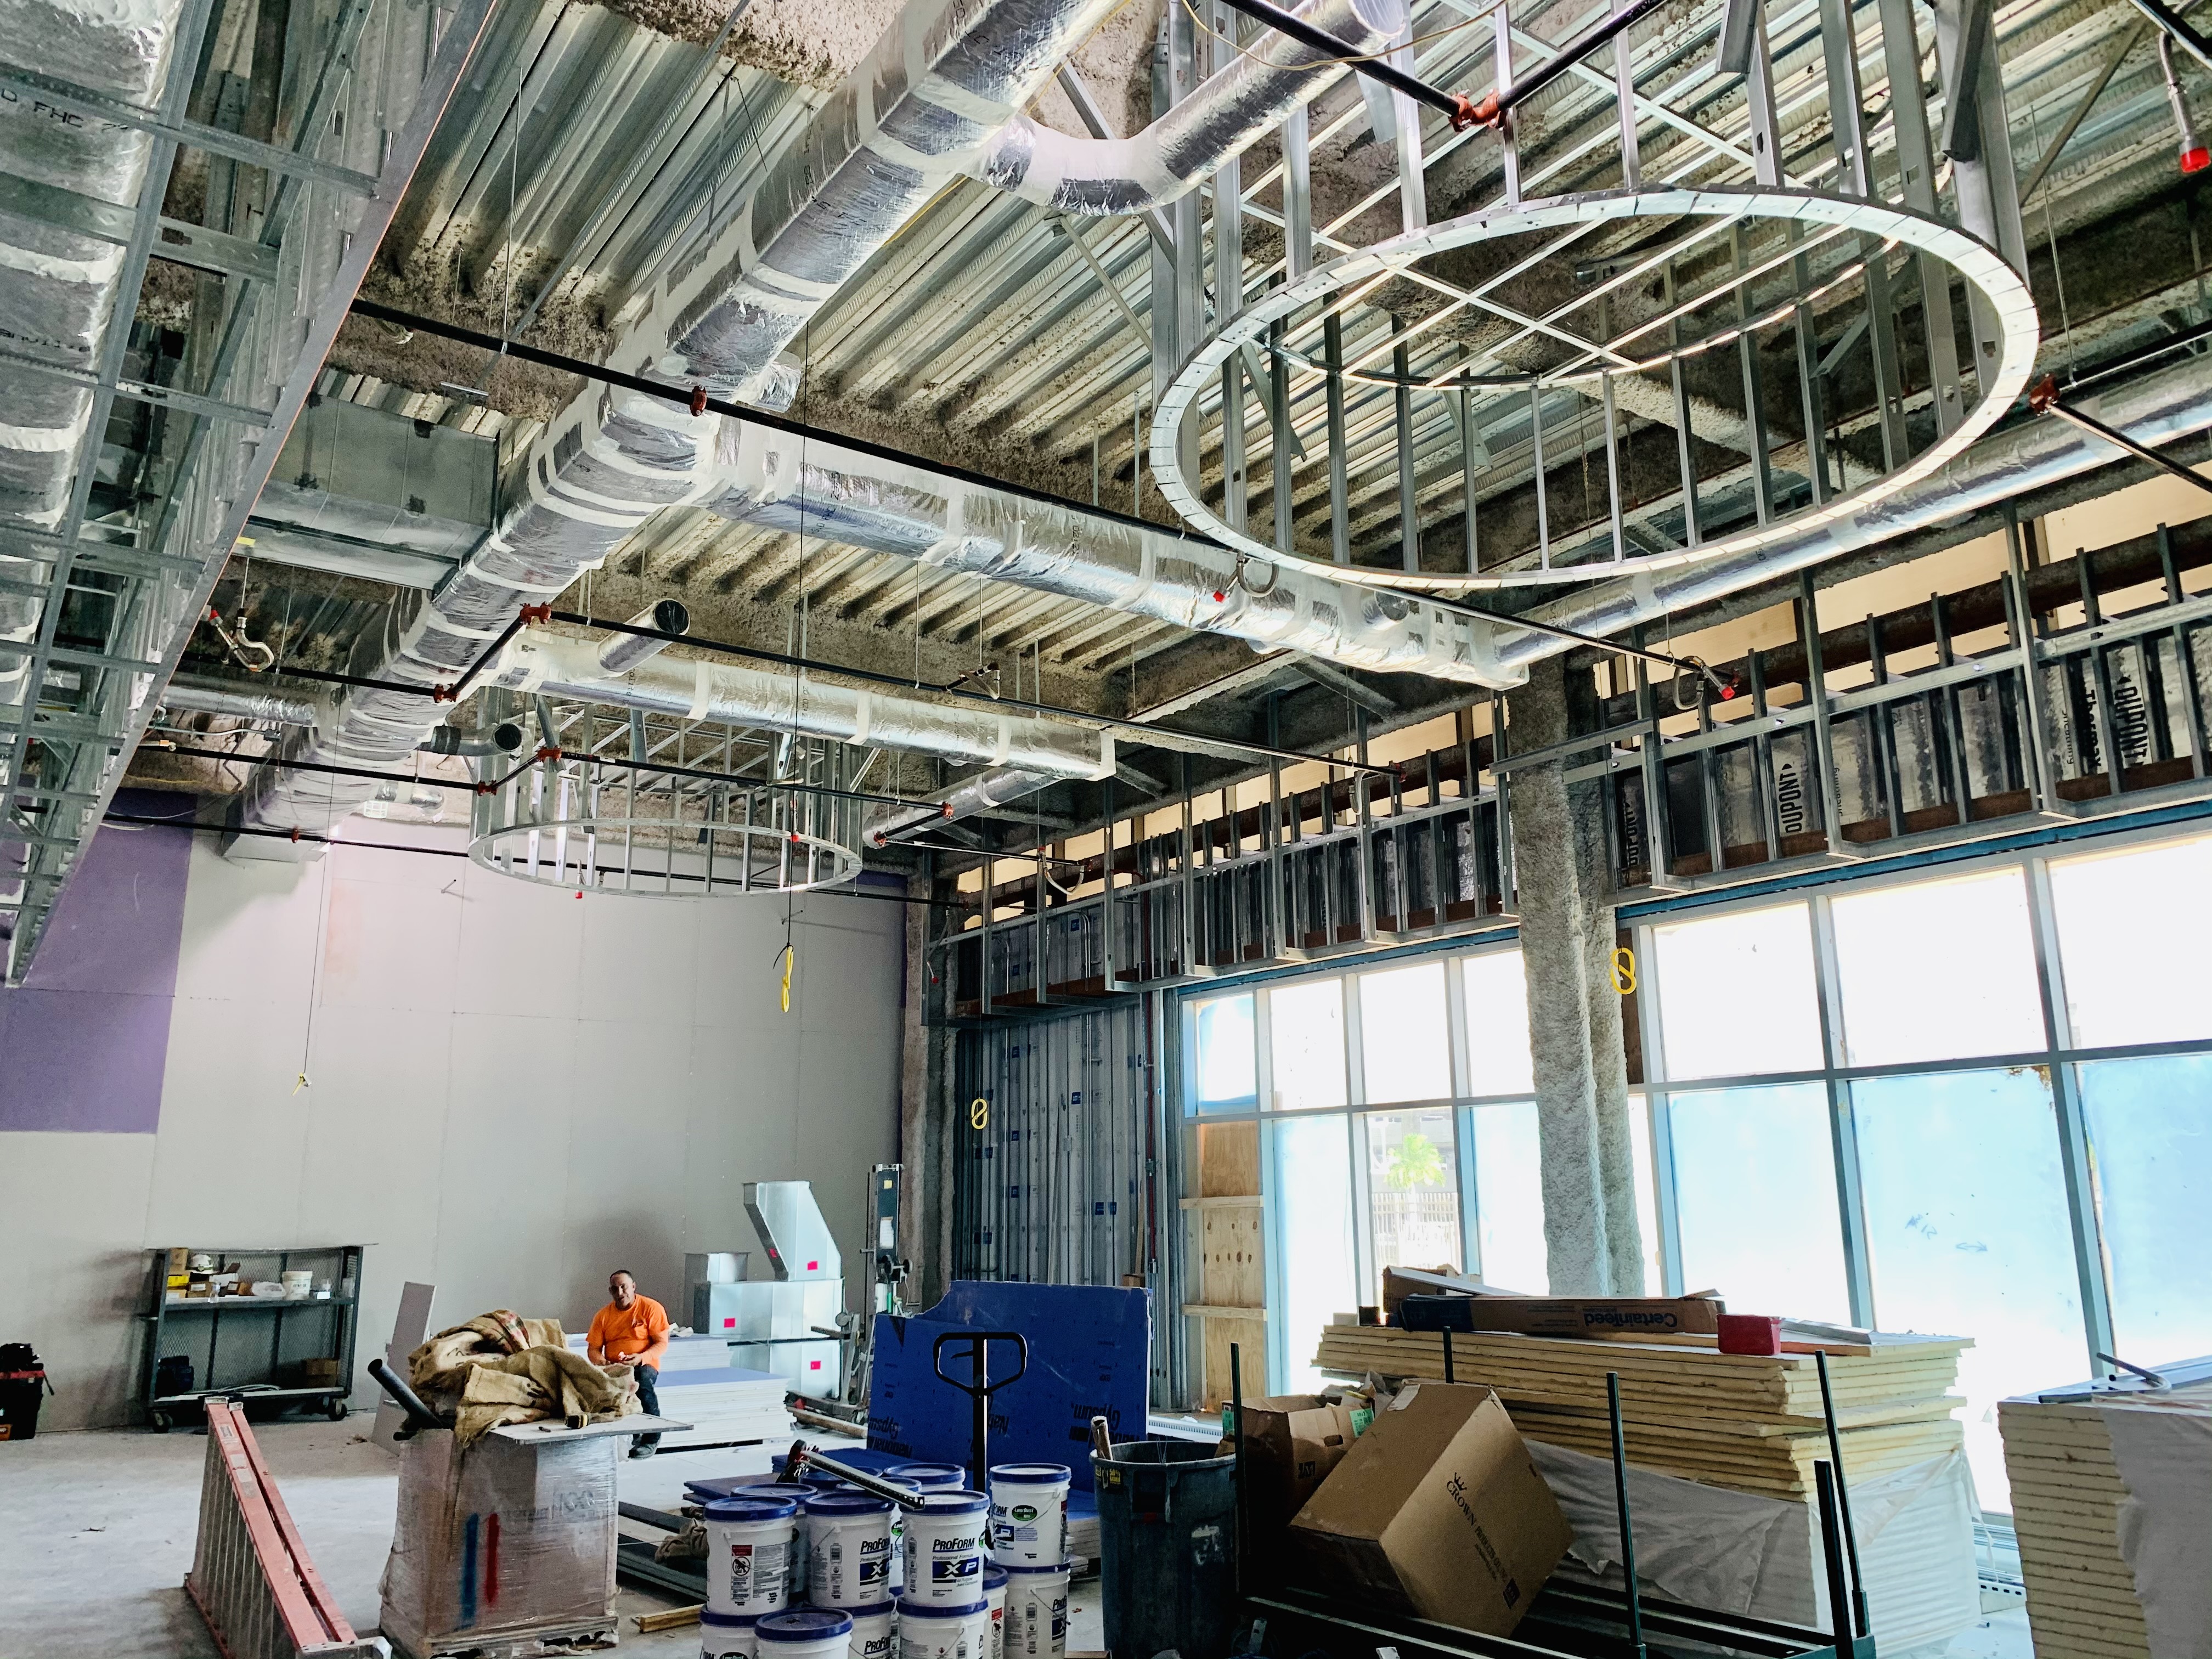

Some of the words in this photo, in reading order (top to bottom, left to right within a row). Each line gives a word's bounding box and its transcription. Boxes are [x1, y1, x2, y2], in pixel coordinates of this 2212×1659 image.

[33, 100, 84, 128] FHC
[2113, 686, 2149, 759] DUPONT
[1778, 772, 1804, 833] DUPONT
[1584, 1312, 1678, 1328] CertainTeed
[1446, 1480, 1476, 1526] CROWN
